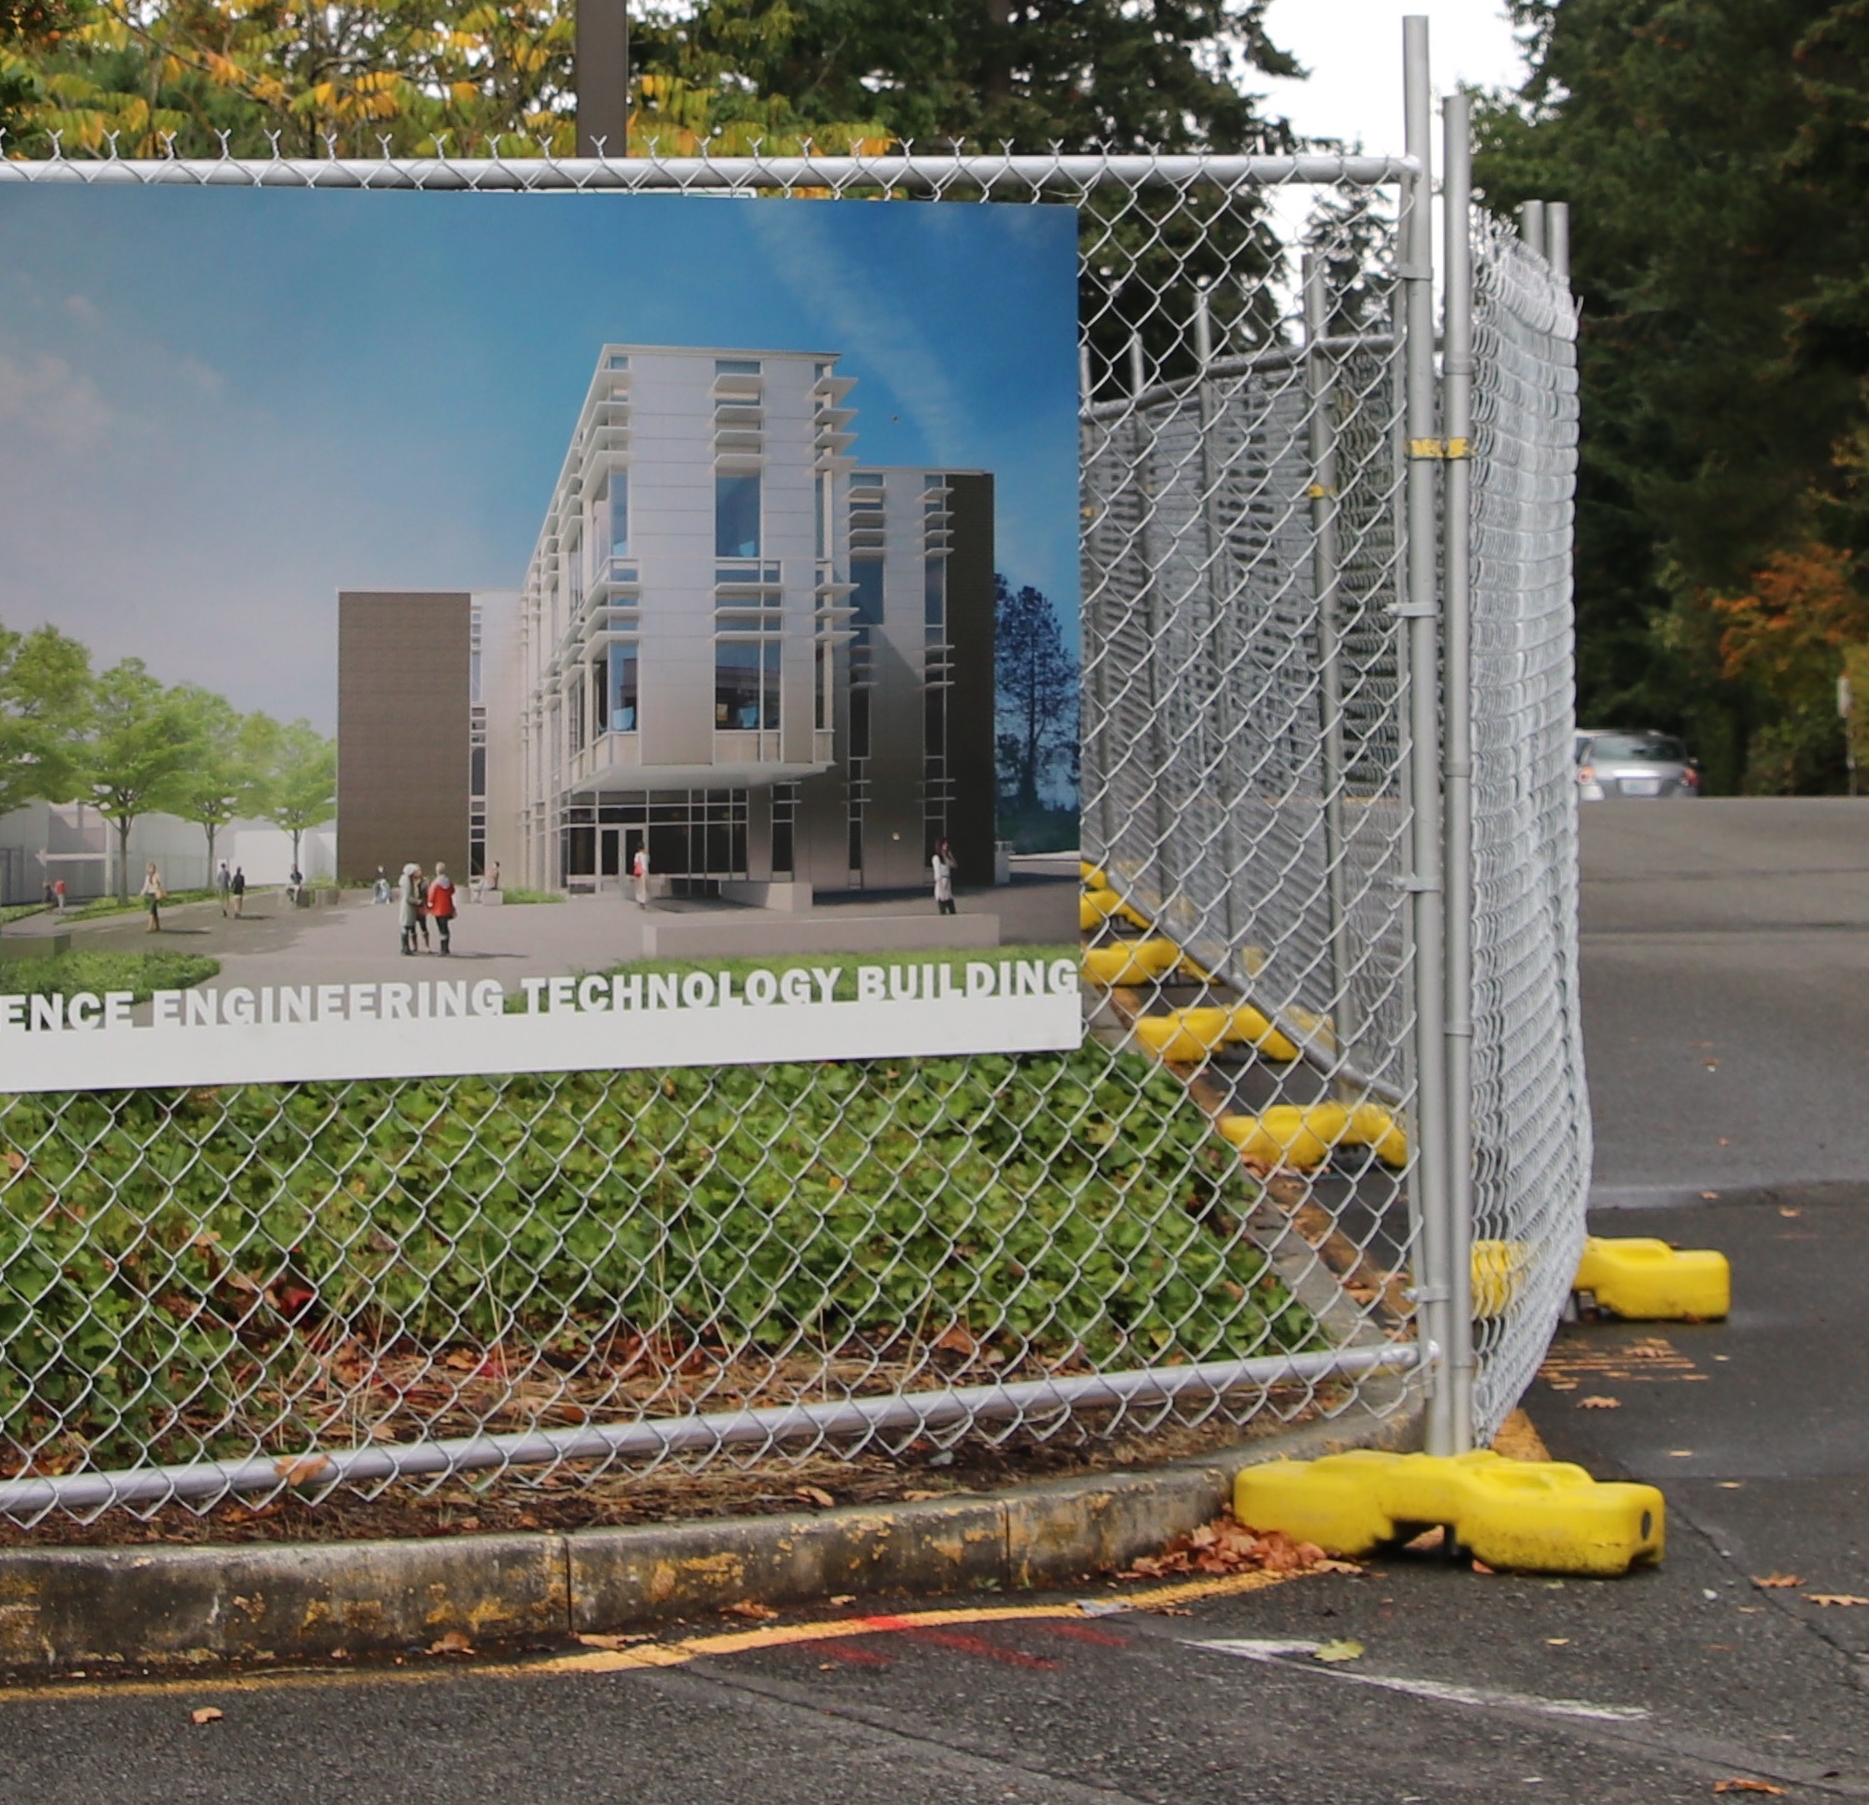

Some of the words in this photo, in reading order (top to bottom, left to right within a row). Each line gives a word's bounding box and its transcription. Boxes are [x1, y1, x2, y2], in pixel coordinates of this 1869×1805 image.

[152, 978, 505, 1028] ENGINEERING
[521, 966, 843, 1014] TECHNOLOGY
[857, 959, 1078, 1002] BUILDING
